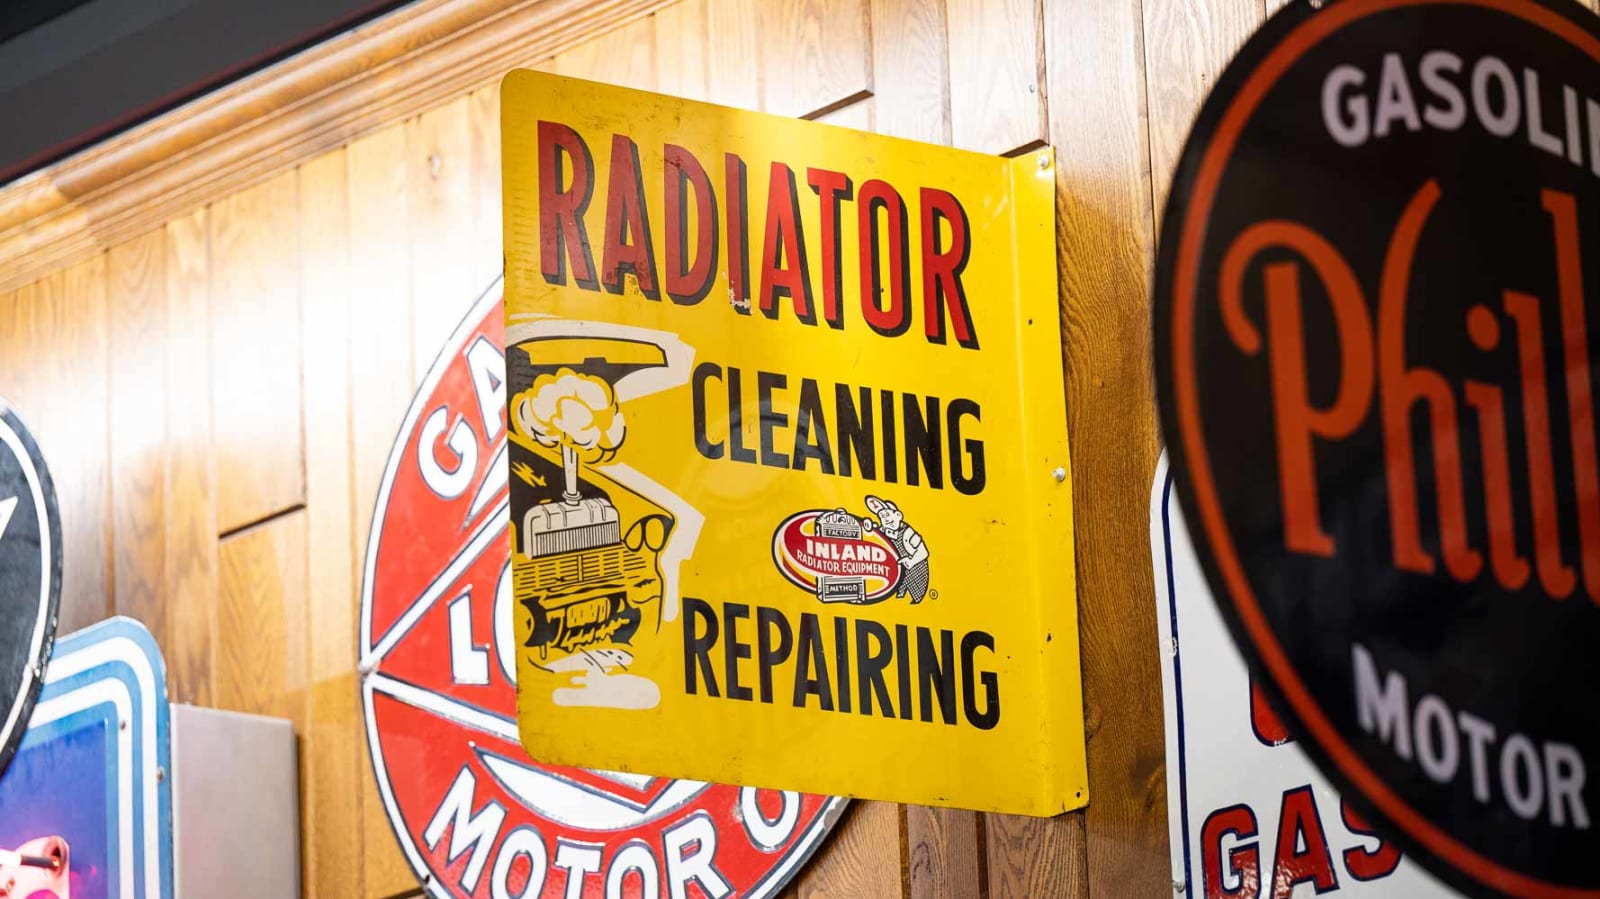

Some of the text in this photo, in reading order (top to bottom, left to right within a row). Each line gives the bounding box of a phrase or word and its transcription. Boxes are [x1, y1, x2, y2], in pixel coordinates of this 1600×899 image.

[537, 120, 980, 350] RADIATOR
[692, 362, 986, 495] CLEANING
[796, 549, 890, 577] RADIATOR EQUIPMENT
[806, 538, 887, 562] INLAND
[827, 528, 857, 538] FACTORY
[829, 584, 858, 593] METHOD
[681, 597, 1001, 730] REPAIRING
[1351, 641, 1590, 830] MOTOR
[423, 762, 738, 899] MOTOR
